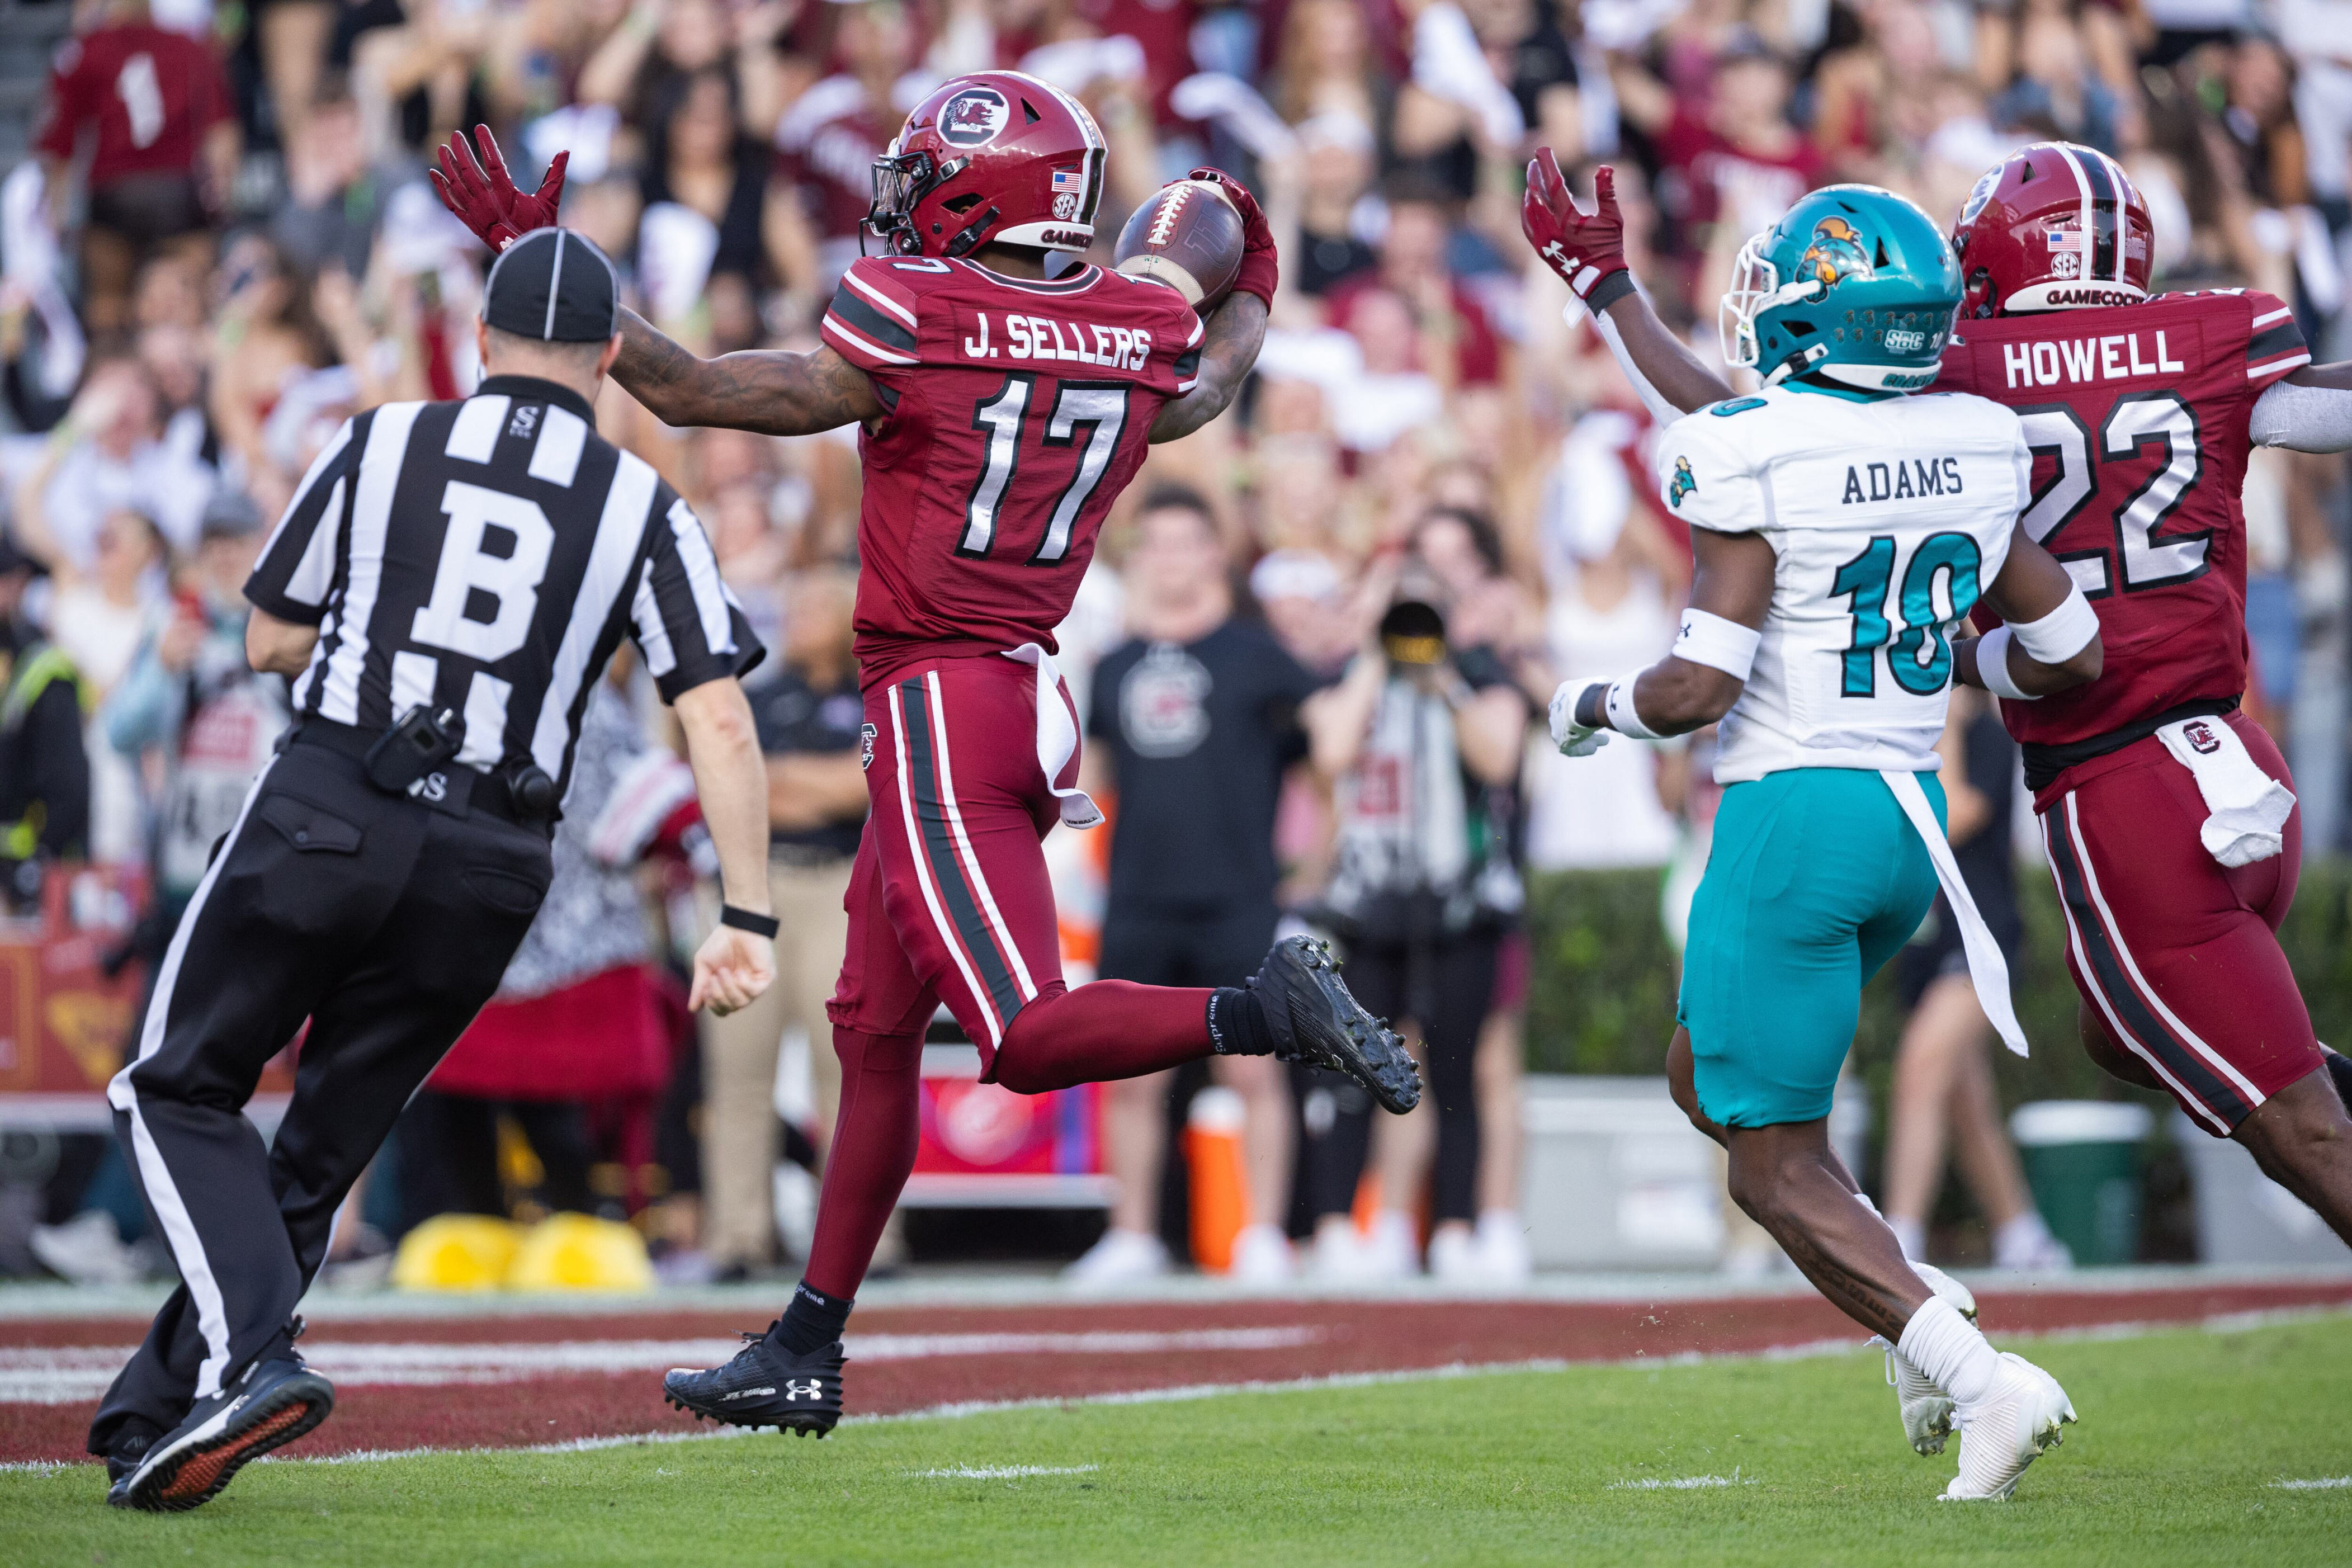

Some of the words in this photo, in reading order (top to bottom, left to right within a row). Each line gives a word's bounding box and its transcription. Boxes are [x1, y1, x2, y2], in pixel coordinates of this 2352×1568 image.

[1054, 193, 1075, 218] SEC
[2053, 253, 2078, 278] SEC
[965, 313, 997, 357] J.
[1007, 314, 1152, 371] SELLERS
[1885, 330, 1925, 350] SBC
[2004, 330, 2184, 388] HOWELL
[953, 371, 1135, 567] 17
[1842, 457, 1962, 504] ADAMS
[2011, 390, 2214, 601] 22
[410, 480, 556, 663] B
[1827, 531, 1982, 698] 10
